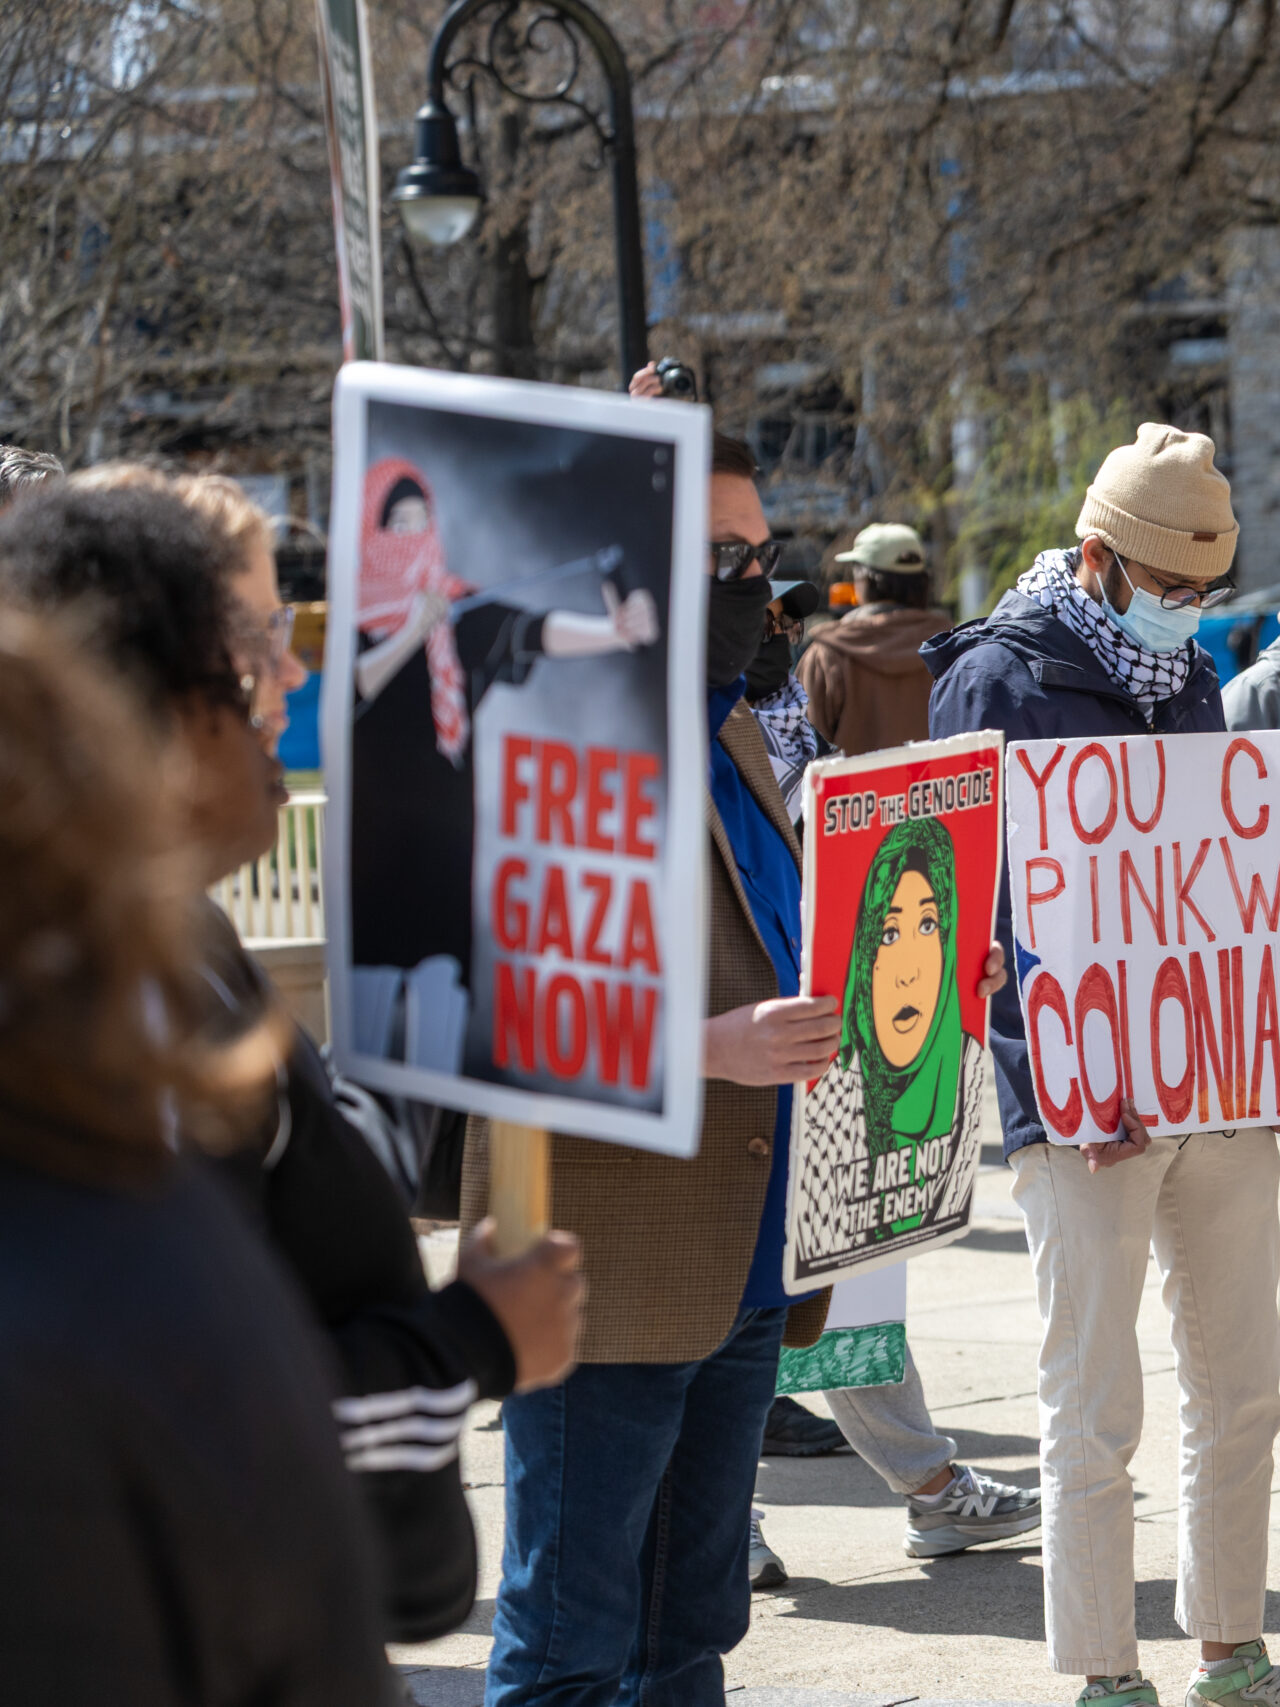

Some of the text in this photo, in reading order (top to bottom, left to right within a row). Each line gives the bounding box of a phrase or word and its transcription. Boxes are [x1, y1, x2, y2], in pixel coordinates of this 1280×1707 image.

[500, 733, 663, 859] FREE
[824, 768, 993, 836] STOP THE GENOCIDE
[1016, 739, 1166, 850] YOU
[491, 858, 663, 976] GAZA
[493, 962, 659, 1091] NOW
[836, 1134, 952, 1201] WE ARE NOT
[847, 1178, 937, 1234] THE ENEMY
